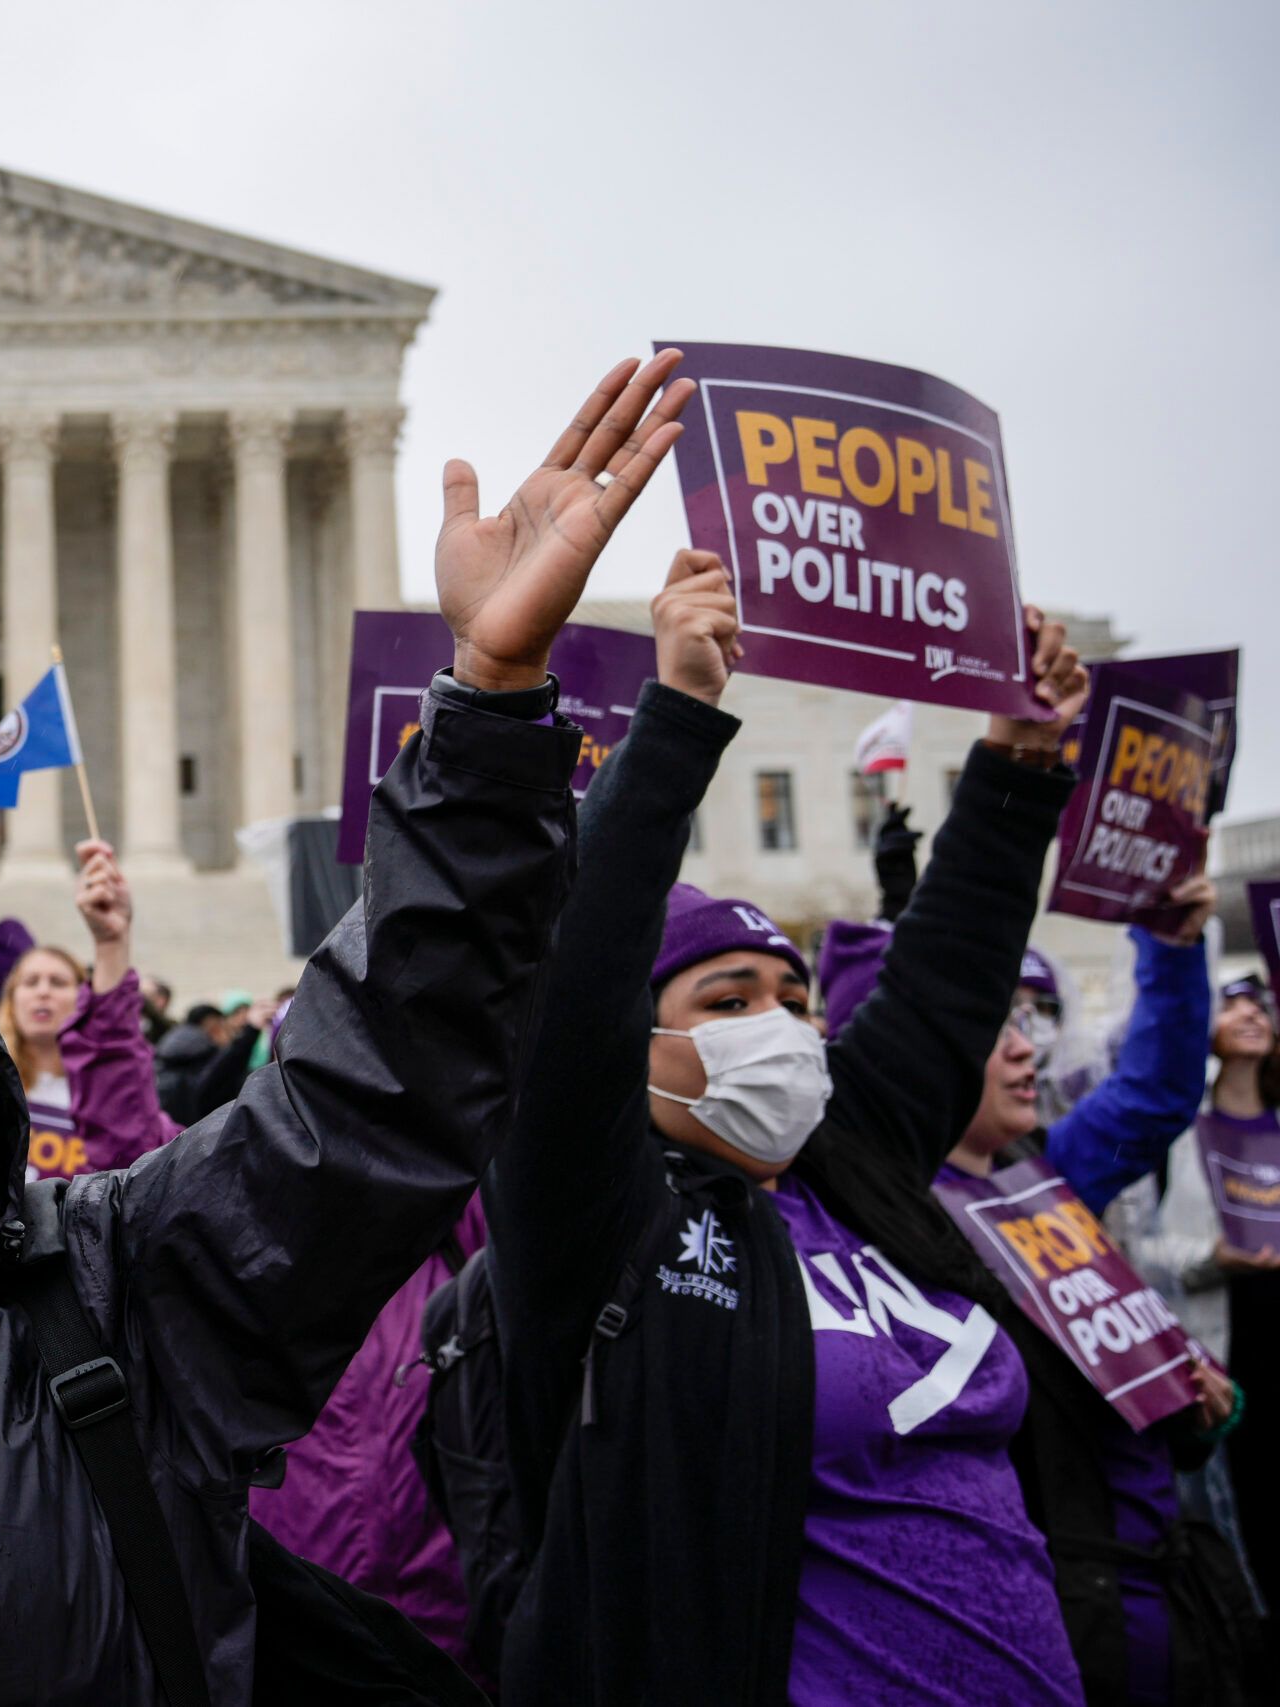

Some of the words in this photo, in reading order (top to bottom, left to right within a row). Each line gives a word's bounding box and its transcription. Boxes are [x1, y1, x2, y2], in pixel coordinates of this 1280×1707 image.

[735, 411, 998, 538] PEOPLE
[752, 491, 865, 551] OVER
[756, 539, 969, 632] POLITICS
[1101, 789, 1151, 831] OVER
[1085, 824, 1180, 882] POLITICS
[1049, 1268, 1118, 1315] OVER
